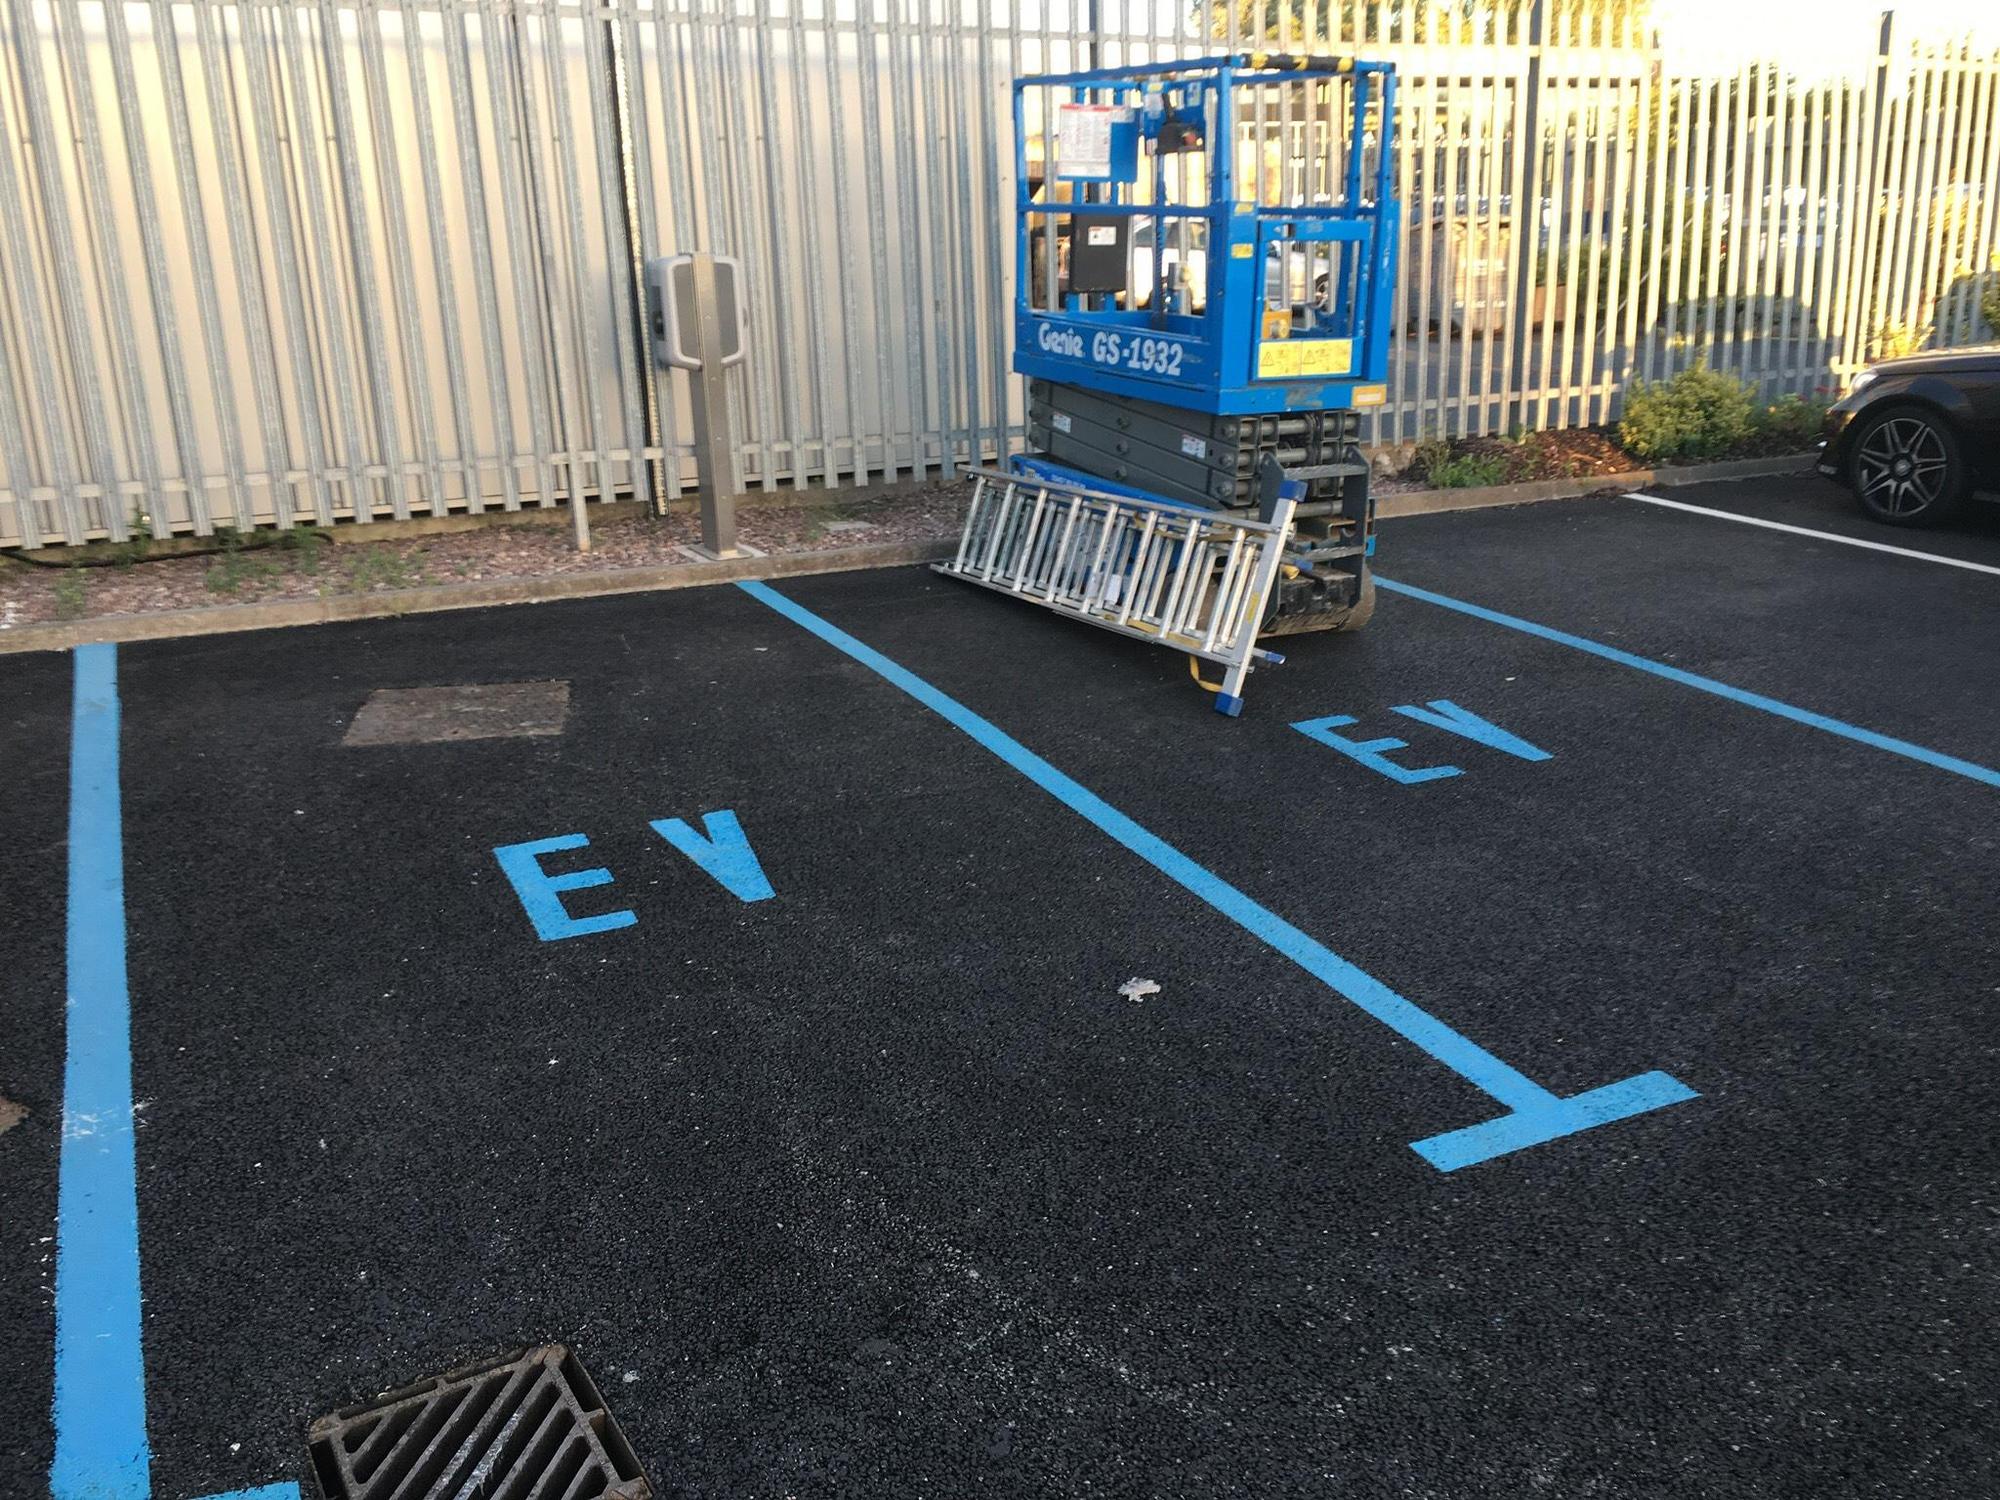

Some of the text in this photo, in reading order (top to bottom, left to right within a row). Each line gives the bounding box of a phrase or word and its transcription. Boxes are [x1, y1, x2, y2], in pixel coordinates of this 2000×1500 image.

[1038, 322, 1184, 376] Genie GS-1932
[1288, 699, 1554, 785] EV
[492, 809, 777, 942] EV
